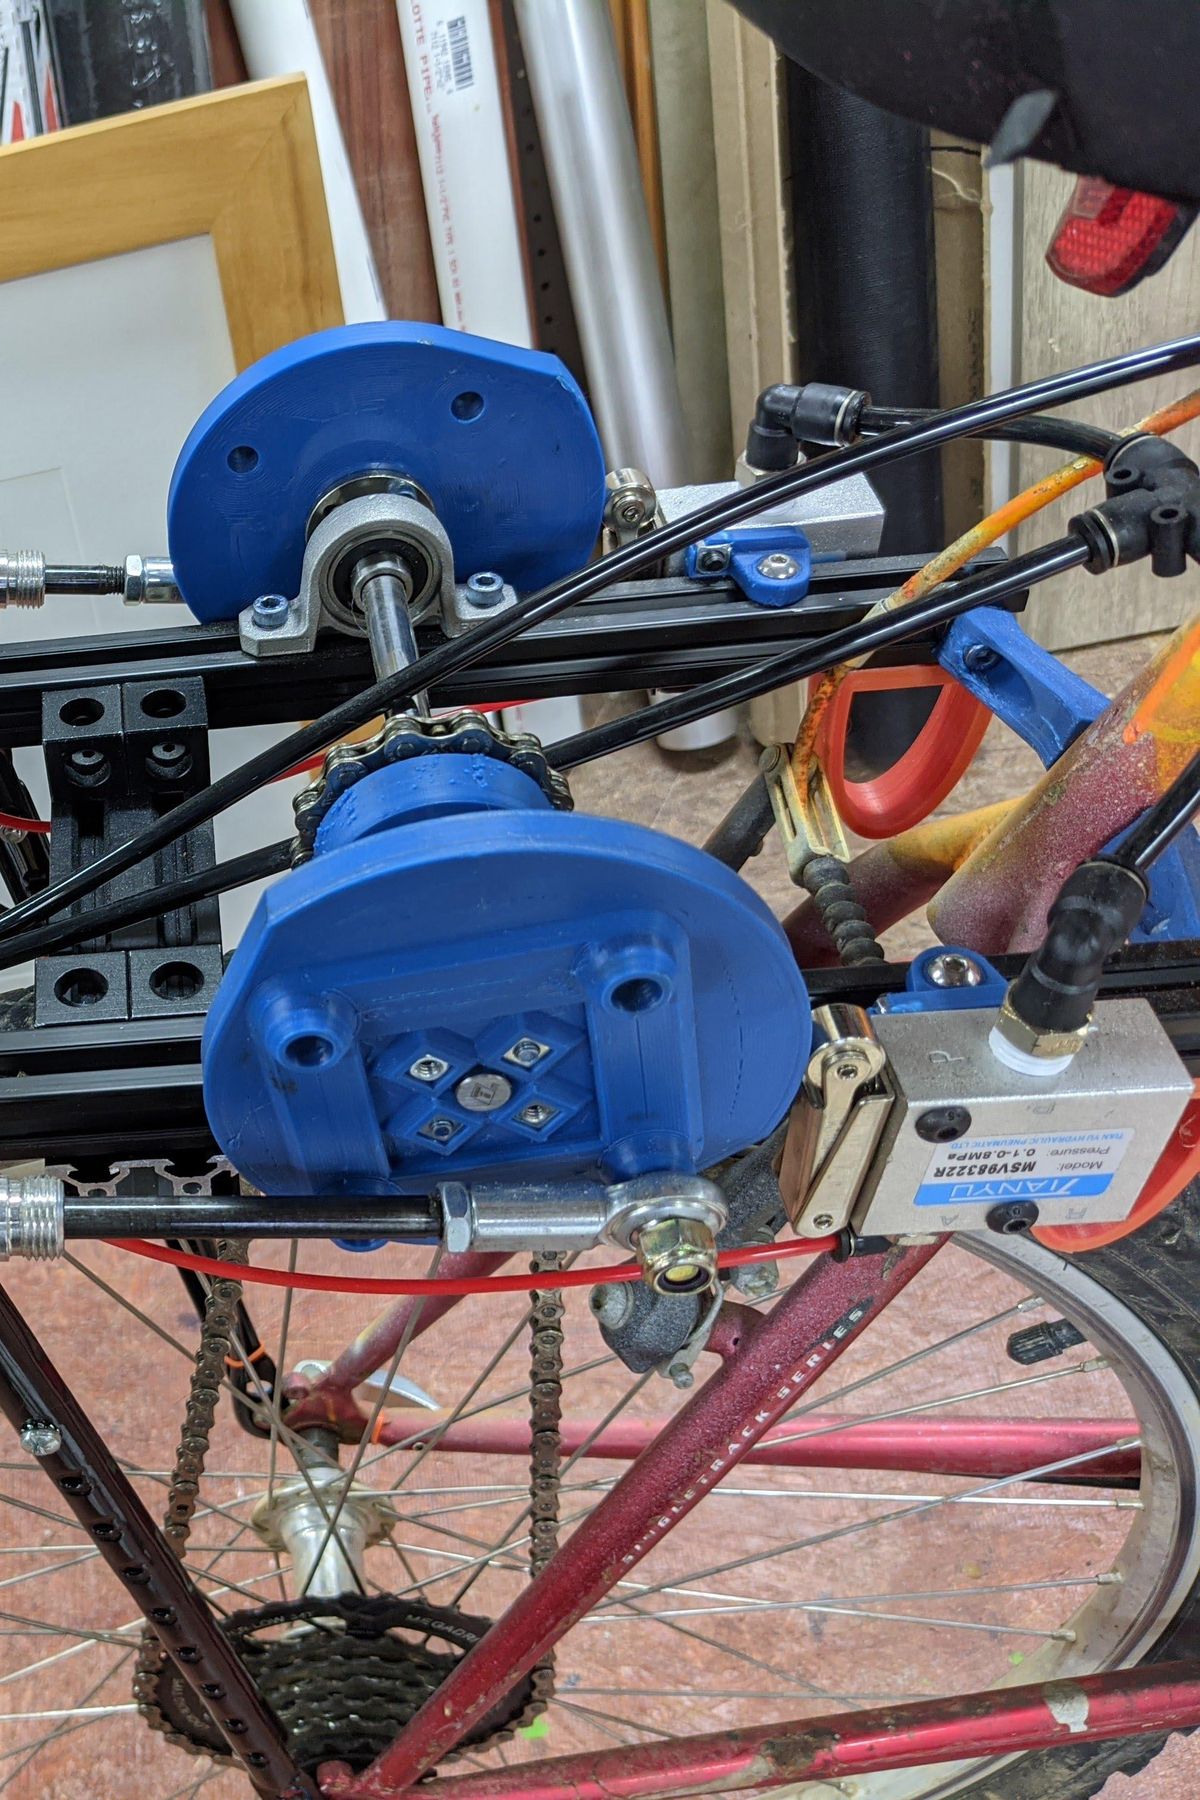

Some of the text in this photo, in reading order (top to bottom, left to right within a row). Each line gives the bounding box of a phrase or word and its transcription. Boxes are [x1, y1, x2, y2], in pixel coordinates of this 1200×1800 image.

[420, 55, 432, 95] PIPE
[973, 1138, 1027, 1149] PNEUMATIC
[1029, 1135, 1085, 1146] HYDRAULIC
[948, 1146, 1110, 1161] Pressure: 0.1-0.8MPa
[933, 1161, 1103, 1178] Model: MSV98322R
[949, 1178, 1080, 1202] TIANYU
[777, 1309, 863, 1400] SERIES
